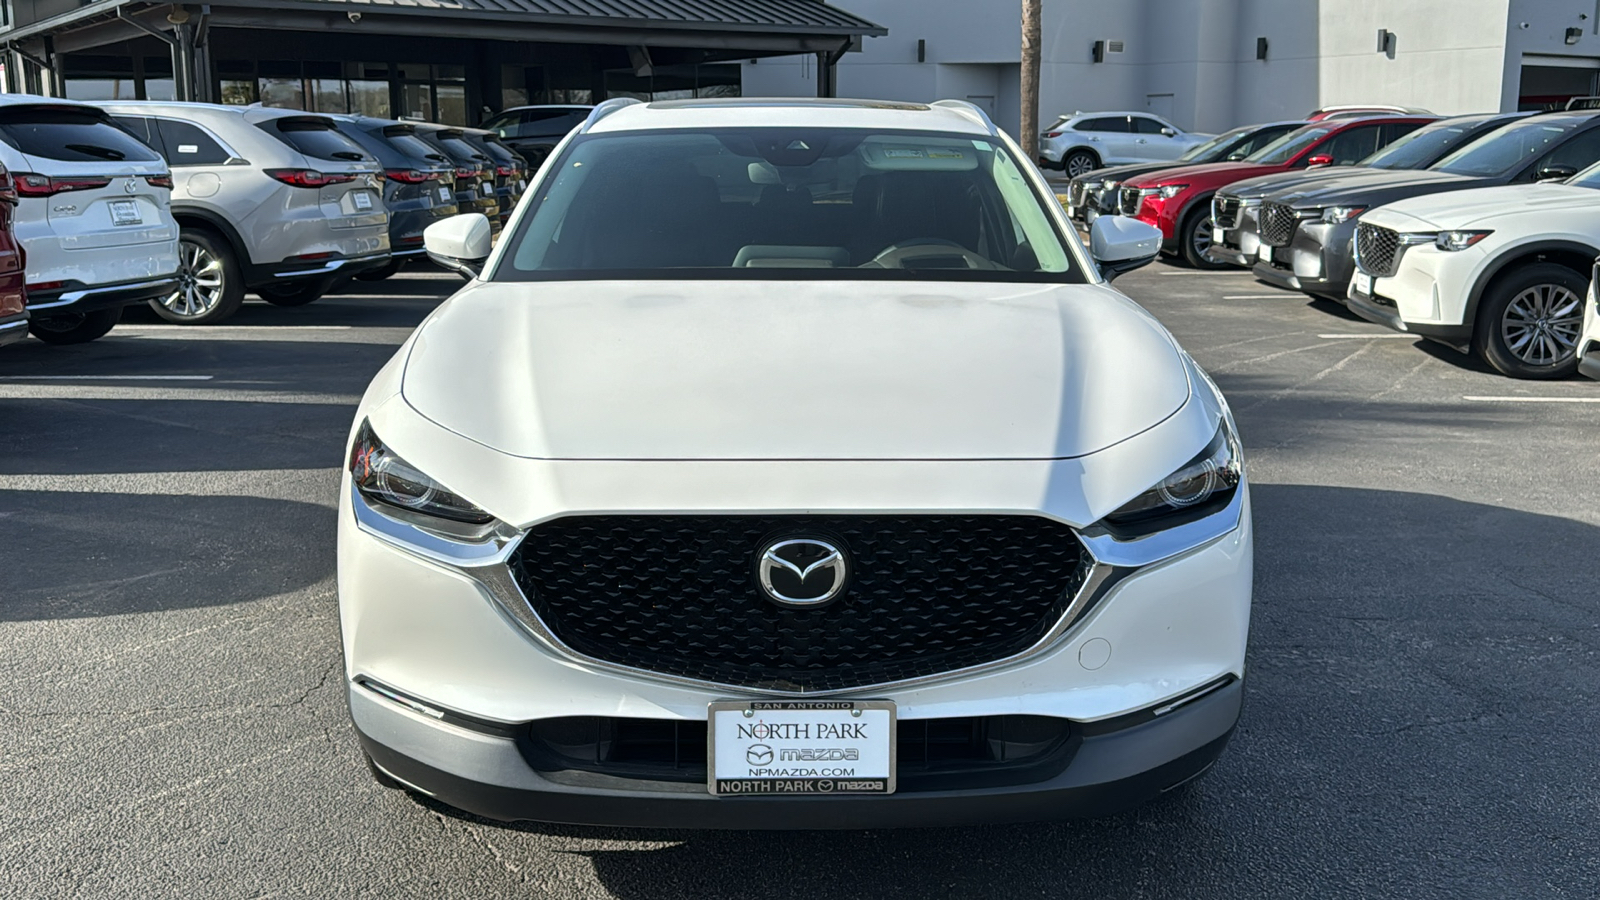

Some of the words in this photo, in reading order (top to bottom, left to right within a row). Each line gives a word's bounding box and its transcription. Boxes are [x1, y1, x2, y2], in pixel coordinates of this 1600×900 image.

[736, 723, 810, 739] NORTH
[816, 723, 868, 739] PARK
[780, 748, 859, 761] mazda
[748, 768, 855, 776] NPMAZDA.COM
[720, 780, 770, 792] NORTH
[775, 780, 814, 792] PARK
[837, 780, 883, 790] mazda
